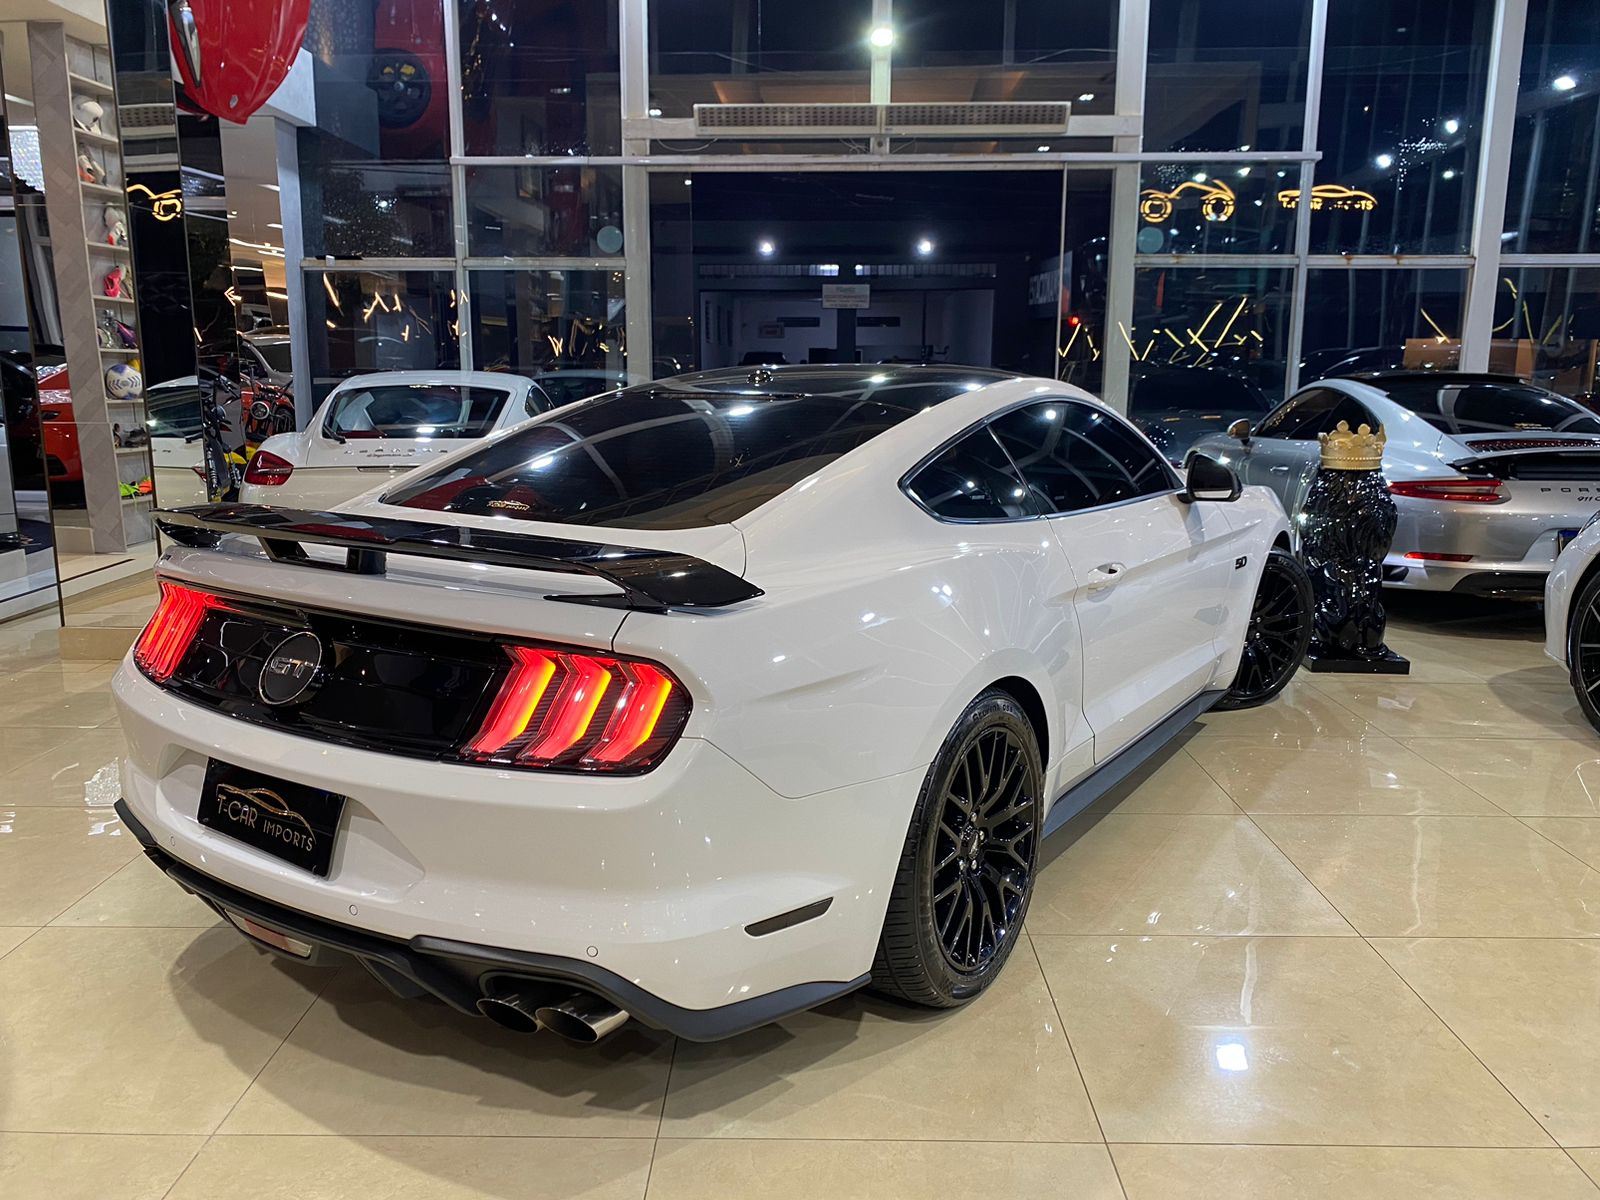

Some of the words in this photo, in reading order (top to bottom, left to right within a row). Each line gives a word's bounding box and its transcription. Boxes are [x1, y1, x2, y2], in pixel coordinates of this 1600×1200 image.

[270, 656, 314, 679] GT
[217, 794, 258, 829] T-CAR
[263, 819, 313, 852] IMPORTS
